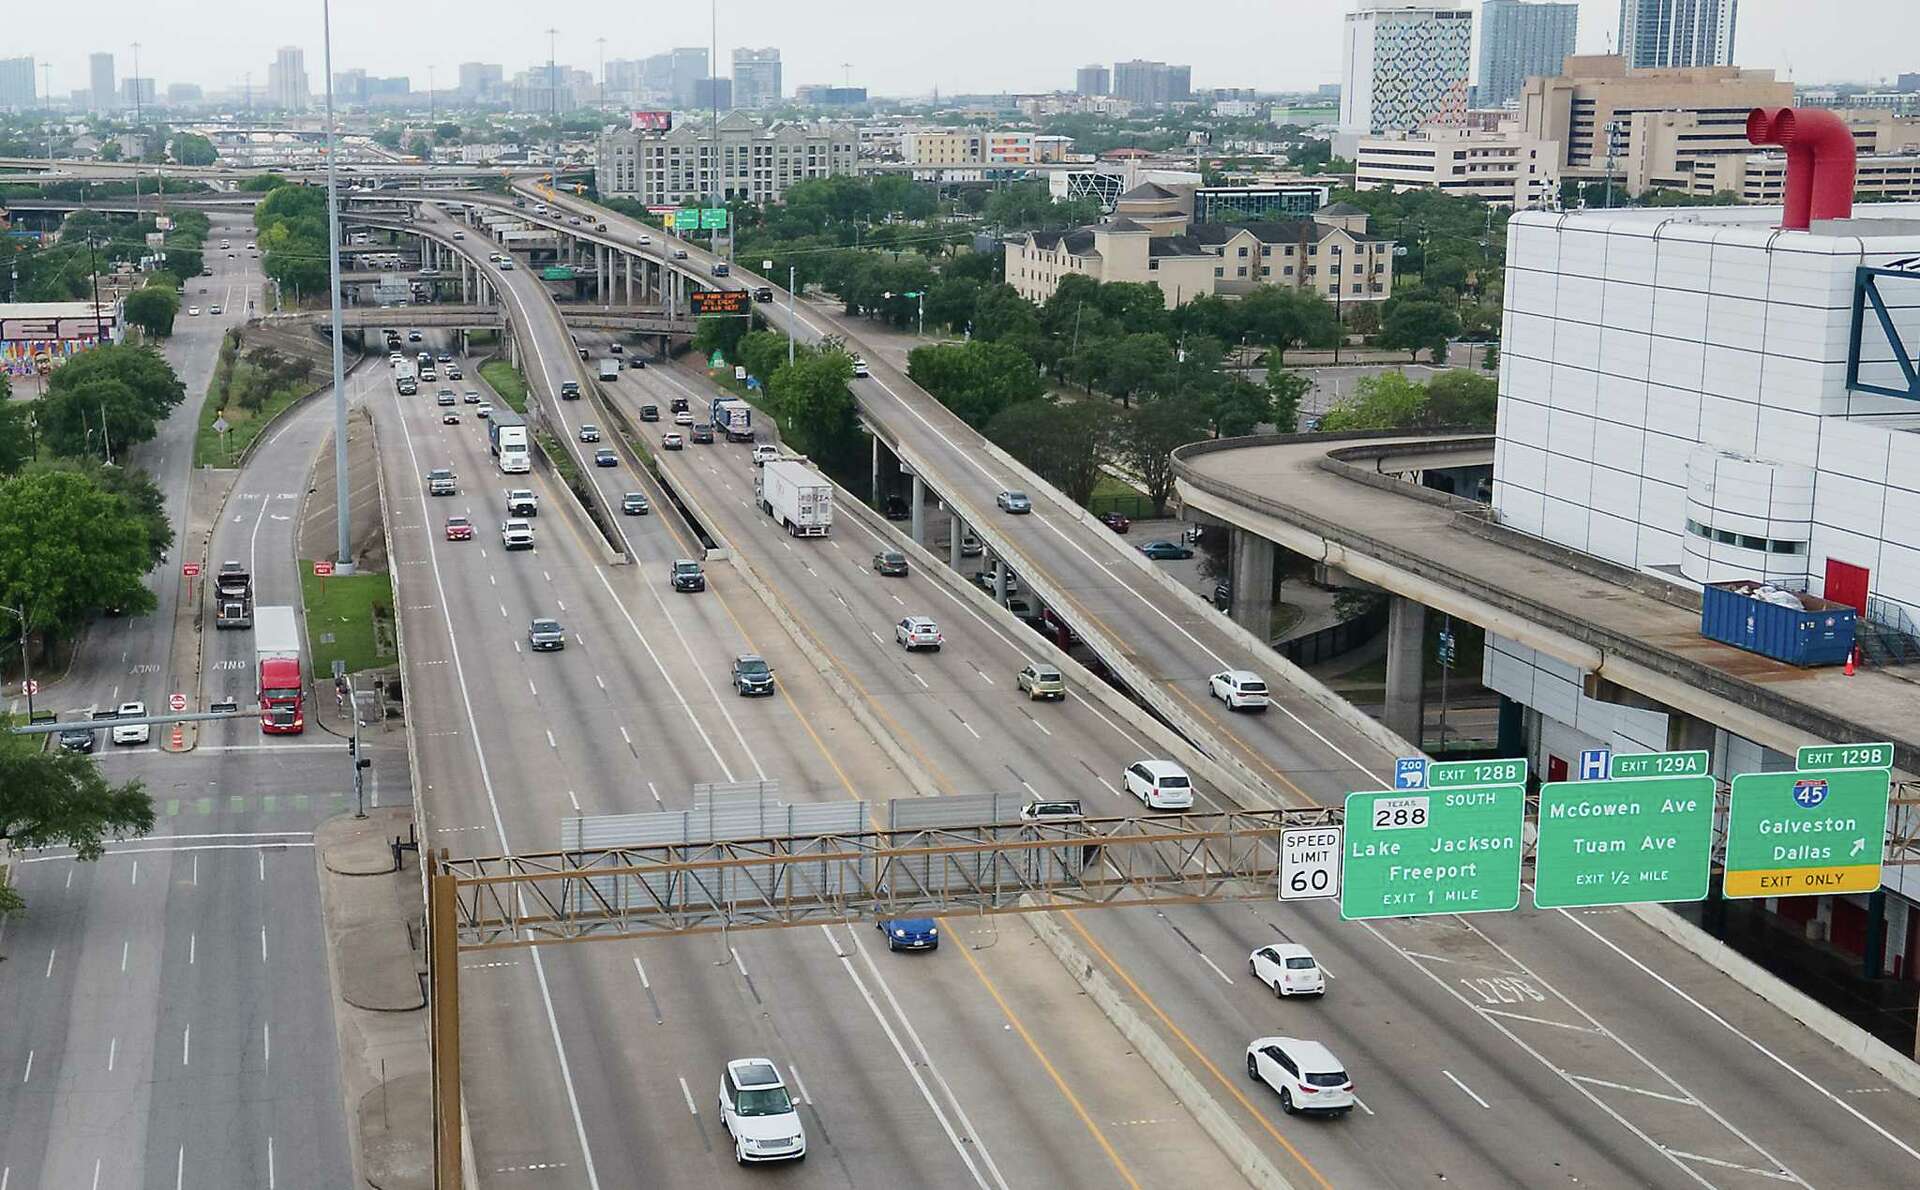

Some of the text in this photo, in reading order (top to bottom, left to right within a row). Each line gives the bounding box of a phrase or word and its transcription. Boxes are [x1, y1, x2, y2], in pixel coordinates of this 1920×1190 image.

[1807, 748, 1882, 764] EXIT 129B
[1400, 761, 1422, 770] ZOO
[1583, 751, 1606, 779] H
[1621, 756, 1697, 773] EXIT 129A
[1439, 765, 1516, 781] EXIT 128B
[1445, 792, 1496, 806] SOUTH
[1797, 786, 1823, 804] 45
[1550, 799, 1697, 818] McGowen Ave
[1376, 808, 1425, 826] 288
[1759, 817, 1856, 834] Galveston
[1287, 834, 1336, 848] SPEED
[1352, 836, 1514, 858] Lake Jackson
[1574, 836, 1677, 854] Tuam Ave
[1291, 850, 1329, 864] LIMIT
[1774, 846, 1831, 861] Dallas
[1389, 863, 1477, 881] Freeport
[1576, 874, 1604, 885] EXIT
[1639, 870, 1669, 881] MILE
[1761, 872, 1845, 888] EXIT ONLY
[1291, 869, 1328, 892] 60
[1383, 889, 1479, 905] EXIT 1 MILE
